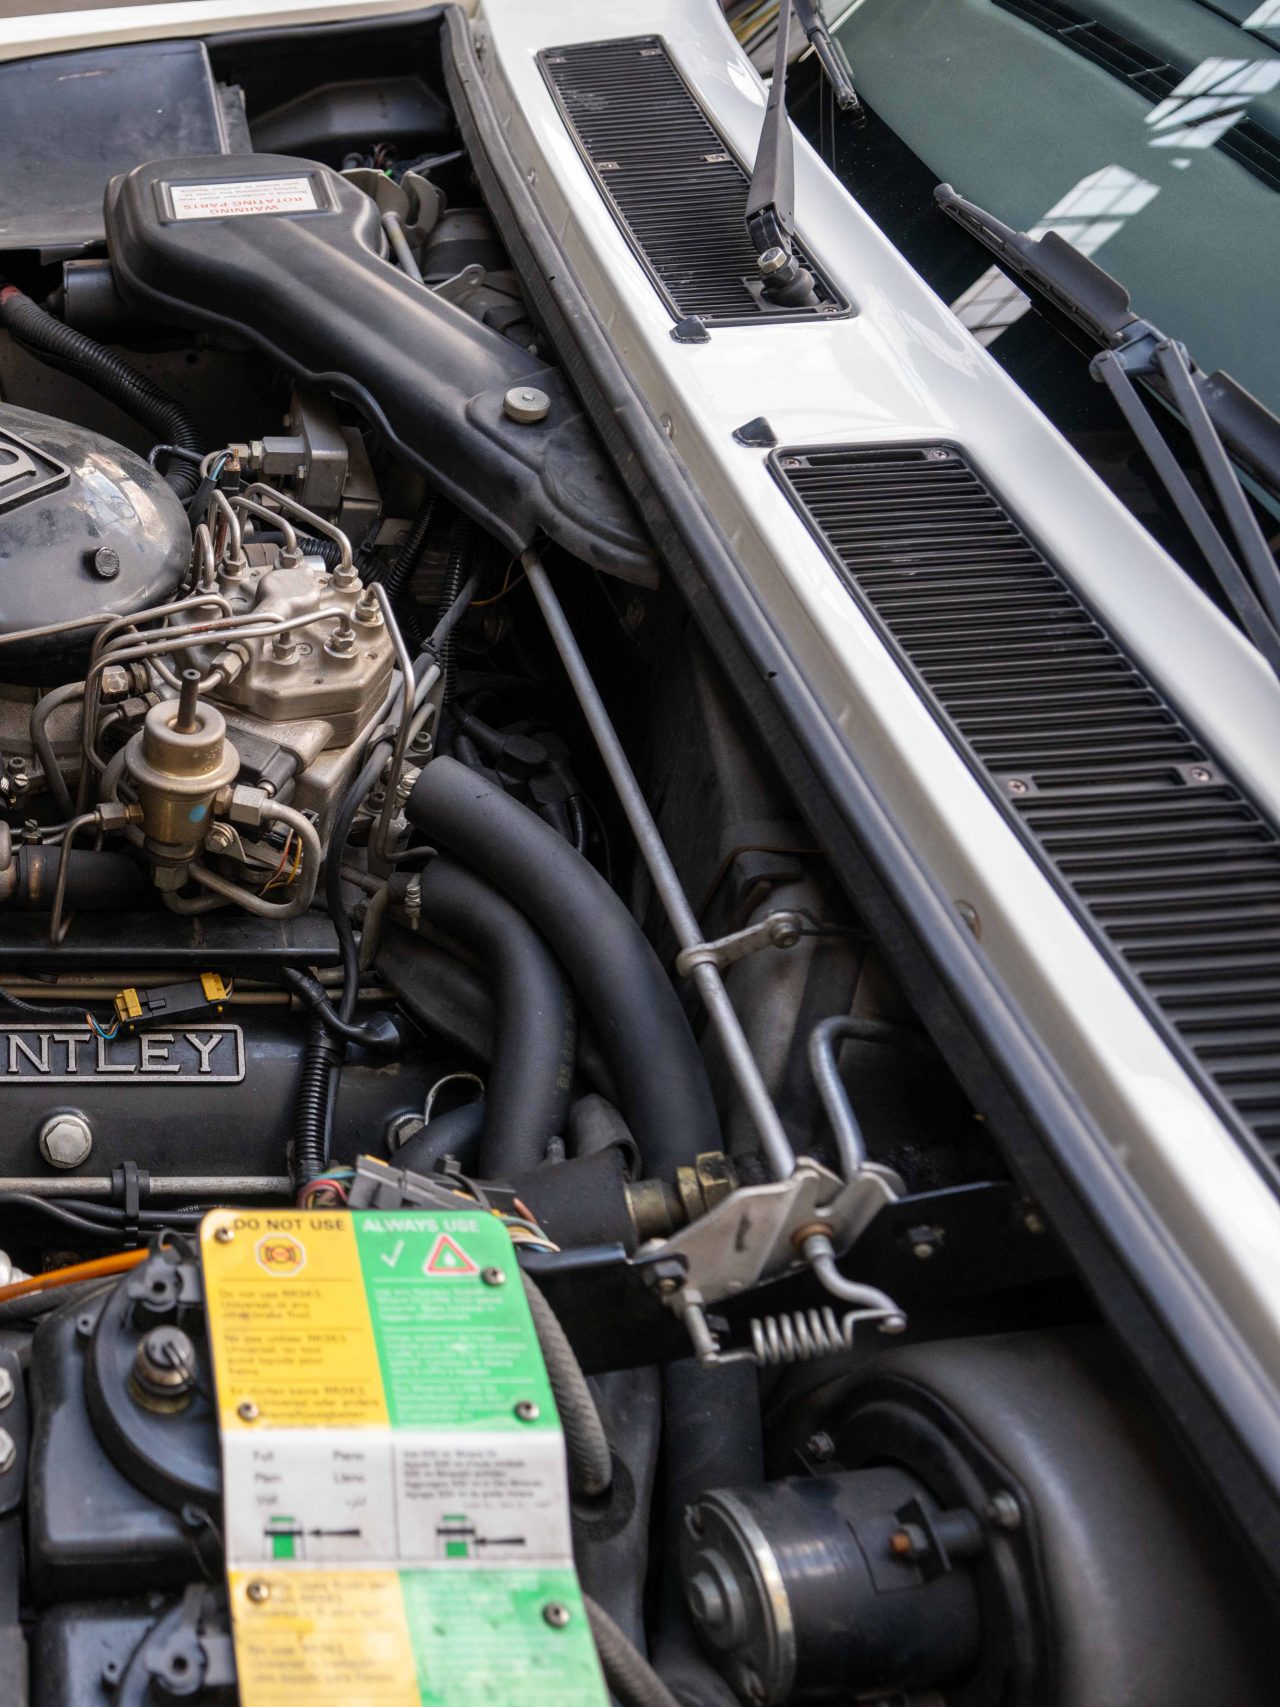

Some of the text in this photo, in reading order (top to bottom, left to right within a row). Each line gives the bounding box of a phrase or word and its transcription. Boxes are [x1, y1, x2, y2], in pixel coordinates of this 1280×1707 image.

[183, 197, 303, 210] ROTATING PARTS
[210, 205, 279, 215] WARNING
[233, 1218, 346, 1231] DO NOT USE
[363, 1218, 480, 1232] ALWAYS USE
